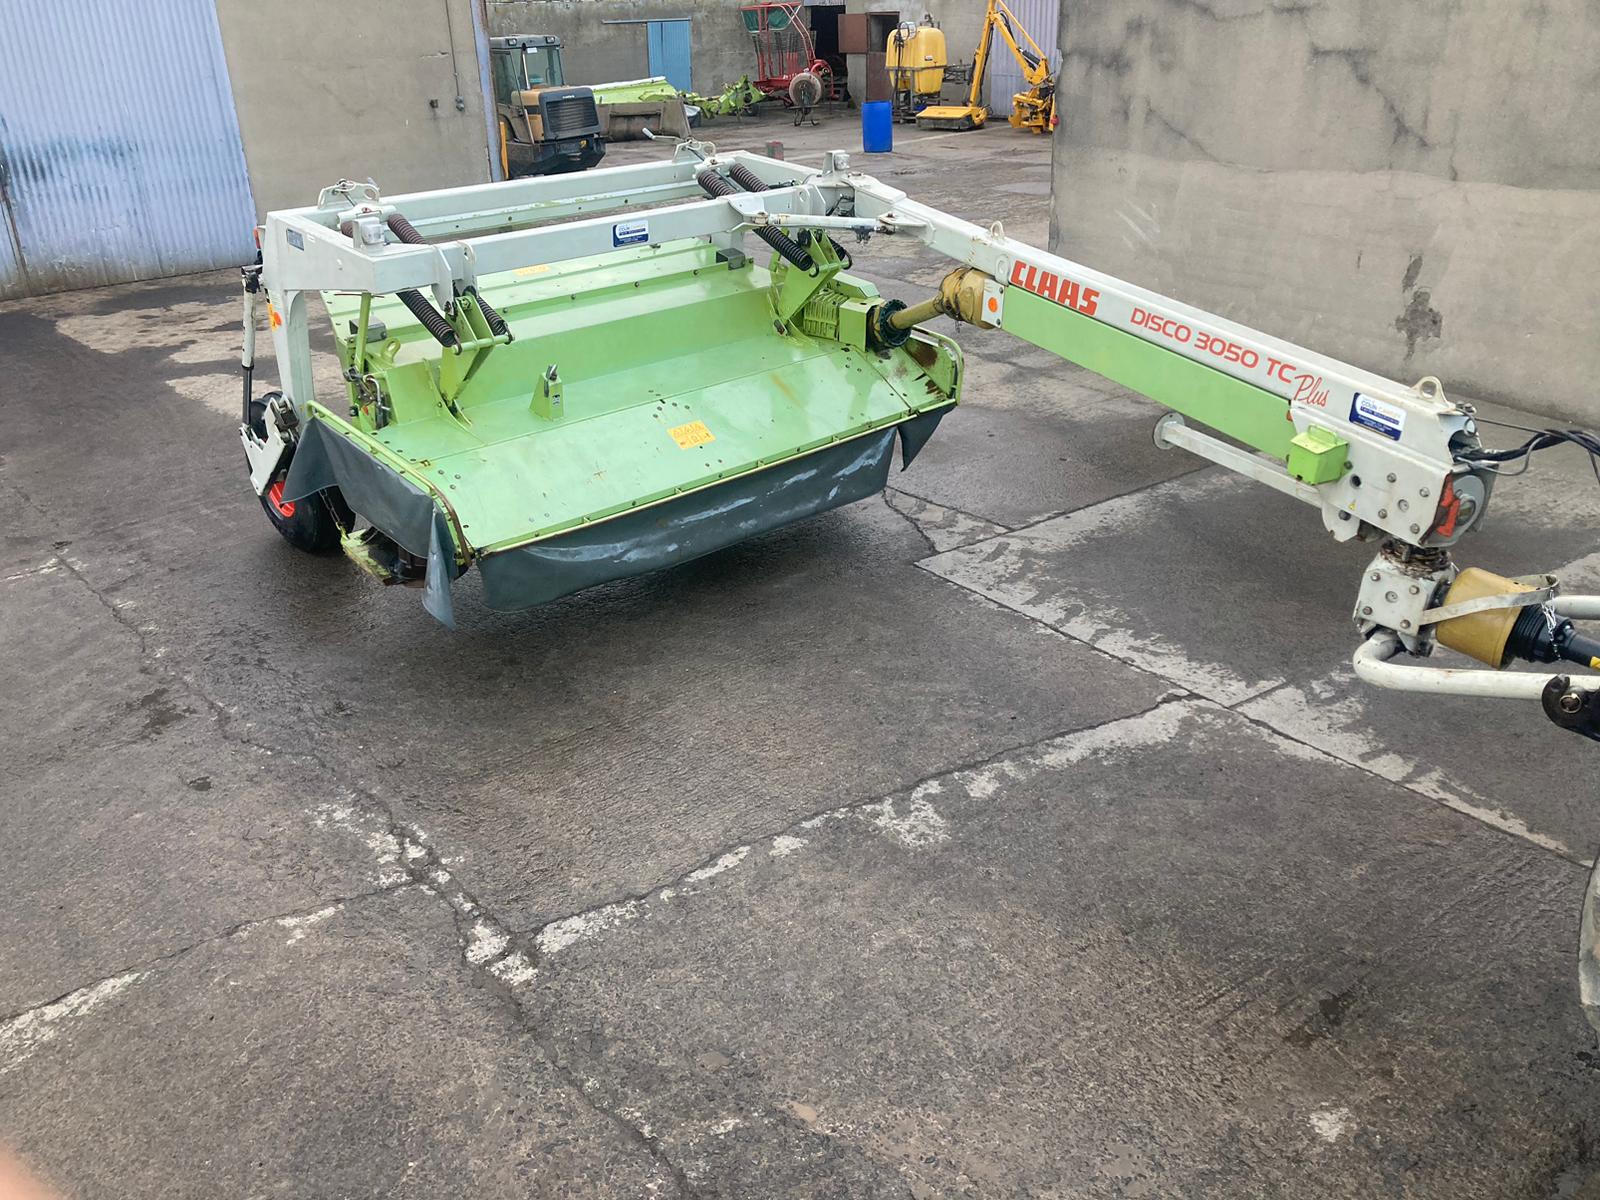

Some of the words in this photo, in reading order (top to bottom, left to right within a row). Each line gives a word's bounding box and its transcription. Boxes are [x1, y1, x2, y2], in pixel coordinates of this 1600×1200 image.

[1010, 260, 1100, 316] CLAAS
[1130, 307, 1192, 343] DISCO
[1194, 331, 1259, 369] 3050
[1266, 357, 1297, 384] TC
[1294, 374, 1330, 408] Plus
